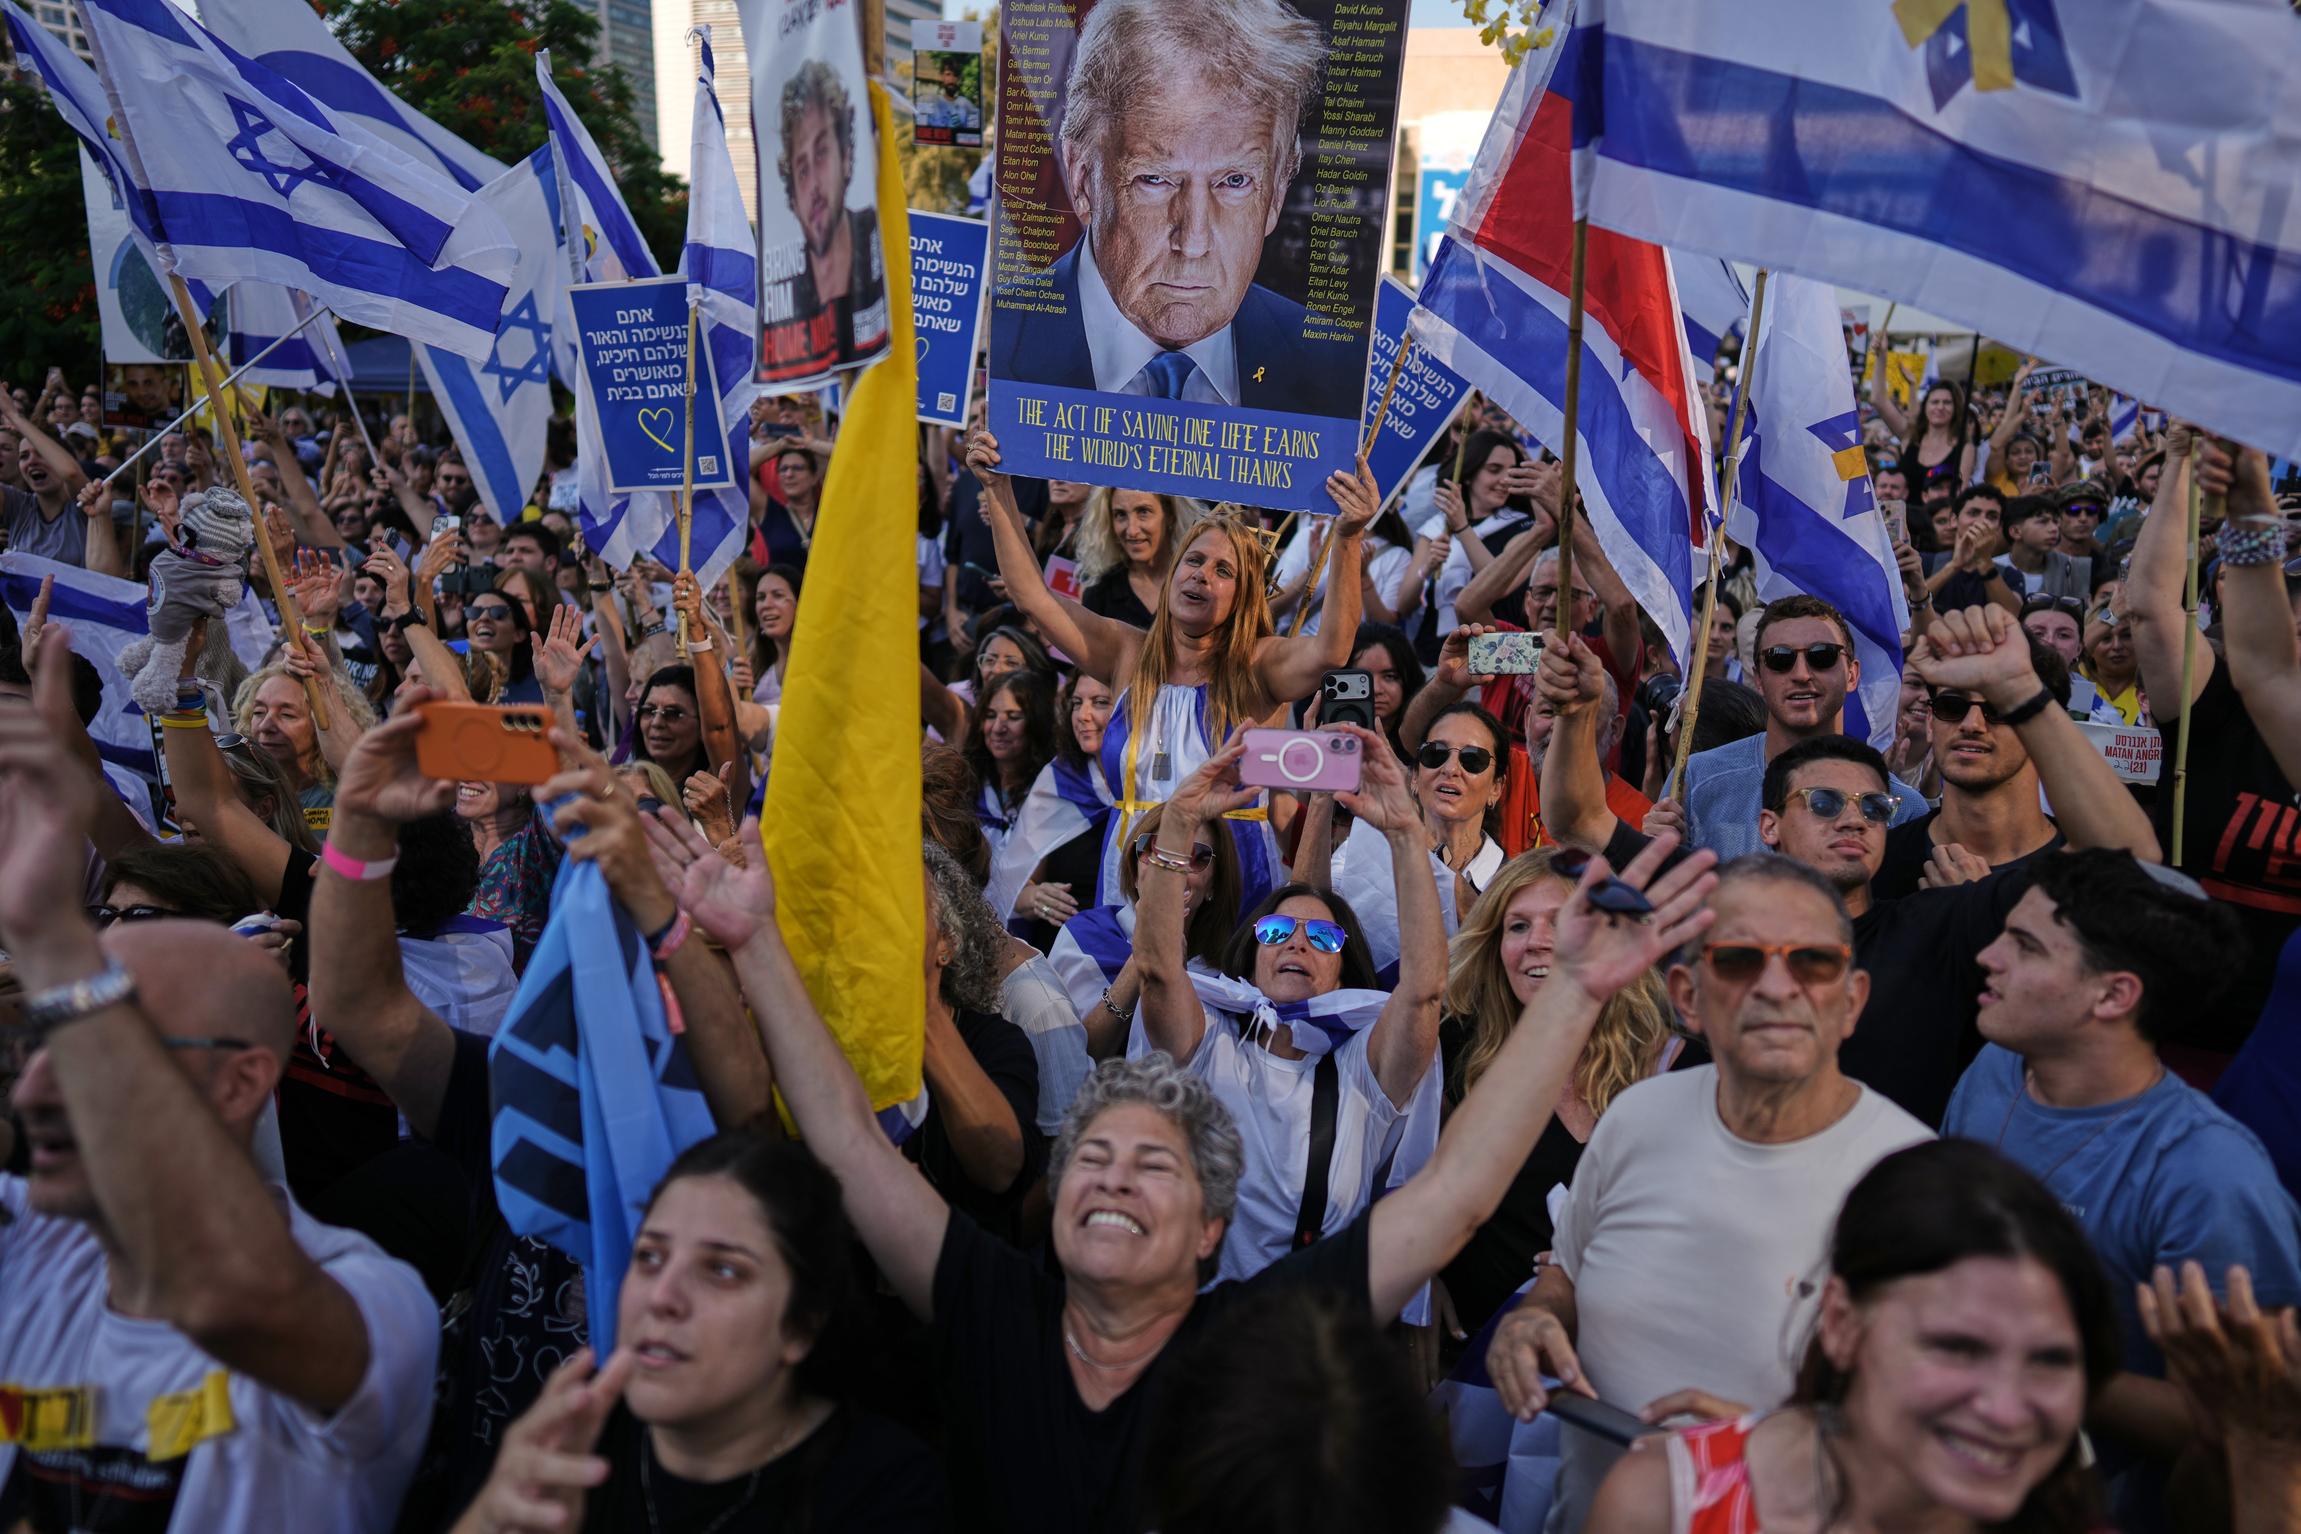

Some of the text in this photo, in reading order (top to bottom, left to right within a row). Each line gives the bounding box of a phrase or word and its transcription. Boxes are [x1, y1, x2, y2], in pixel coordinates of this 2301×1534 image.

[1334, 3, 1384, 15] David Kunio
[1009, 17, 1034, 27] Joshua
[1332, 19, 1398, 34] Eliyahu Margalit
[1011, 31, 1050, 41] Ariel Kunio
[1331, 35, 1386, 48] Asaf Hamami
[1009, 45, 1050, 55] Ziv Berman
[1329, 50, 1384, 63] Sahar Baruch
[1007, 59, 1051, 70] Gali Berman
[1327, 65, 1382, 77] Inbar Haiman
[1043, 75, 1053, 84] Or
[1006, 87, 1058, 100] Bar Kuperstein
[1326, 80, 1343, 94] Guy
[1006, 101, 1045, 112] Omri Miran
[1324, 96, 1365, 108] Tal Chaimi
[1005, 115, 1052, 127] Tamir Nimrodi
[1323, 109, 1376, 122] Yossi Sharabi
[1005, 129, 1054, 142] Matan angrest
[1320, 124, 1385, 138] Manny Goddard
[1003, 142, 1053, 155] Nimrod Cohen
[1318, 138, 1369, 152] Daniel Perez
[1002, 155, 1020, 165] Eitan
[1318, 154, 1356, 166] Itay Chen
[1003, 170, 1038, 181] Alon Ohel
[1316, 168, 1368, 181] Hadar Goldin
[1002, 183, 1036, 195] Eitan mor
[1315, 183, 1354, 195] Oz Daniel
[1001, 198, 1047, 210] Eviatar David
[1313, 197, 1329, 208] Lior
[1000, 211, 1065, 224] Aryeh Zalmanovich
[1311, 211, 1362, 225] Omer Nautra
[1000, 224, 1056, 237] Segev Chalphon
[1330, 227, 1358, 239] Baruch
[909, 236, 943, 255] אתם
[999, 237, 1022, 247] Elkana
[1310, 238, 1340, 250] Dror Or
[998, 250, 1053, 264] Rom Breslavsky
[1309, 251, 1327, 260] Ran
[914, 256, 975, 279] הנשימה
[998, 262, 1056, 276] Matan Zangauker
[1309, 262, 1350, 275] Tamir Adar
[920, 276, 968, 296] שלהם
[997, 274, 1054, 287] Guy Gilboa Dalal
[1308, 276, 1349, 291] Eitan Levy
[996, 286, 1065, 301] Yosef Chaim Ochana
[1307, 288, 1349, 301] Ariel Kunio
[764, 281, 794, 324] HIM
[911, 293, 952, 313] מאוש
[996, 299, 1067, 315] Muhammad Al-Atrash
[1305, 301, 1356, 316] Ronen Engel
[616, 308, 654, 324] אתם
[913, 312, 961, 333] שאתם
[1303, 314, 1364, 330] Amiram Cooper
[586, 329, 628, 346] והאור
[1302, 328, 1355, 343] Maxim Harkin
[1374, 328, 1402, 357] והא
[596, 343, 688, 366] שלהם חיכינו,
[613, 364, 682, 382] מאושרים
[607, 387, 644, 401] בבית
[1395, 373, 1442, 410] שלהם
[1016, 397, 1320, 460] THE ACT OF SAVING ONE LIFE EARNS
[1043, 431, 1293, 489] THE WORLD'S ETERNAL THANKS
[2149, 736, 2162, 749] תן
[2105, 746, 2160, 761] MATAN ANGR
